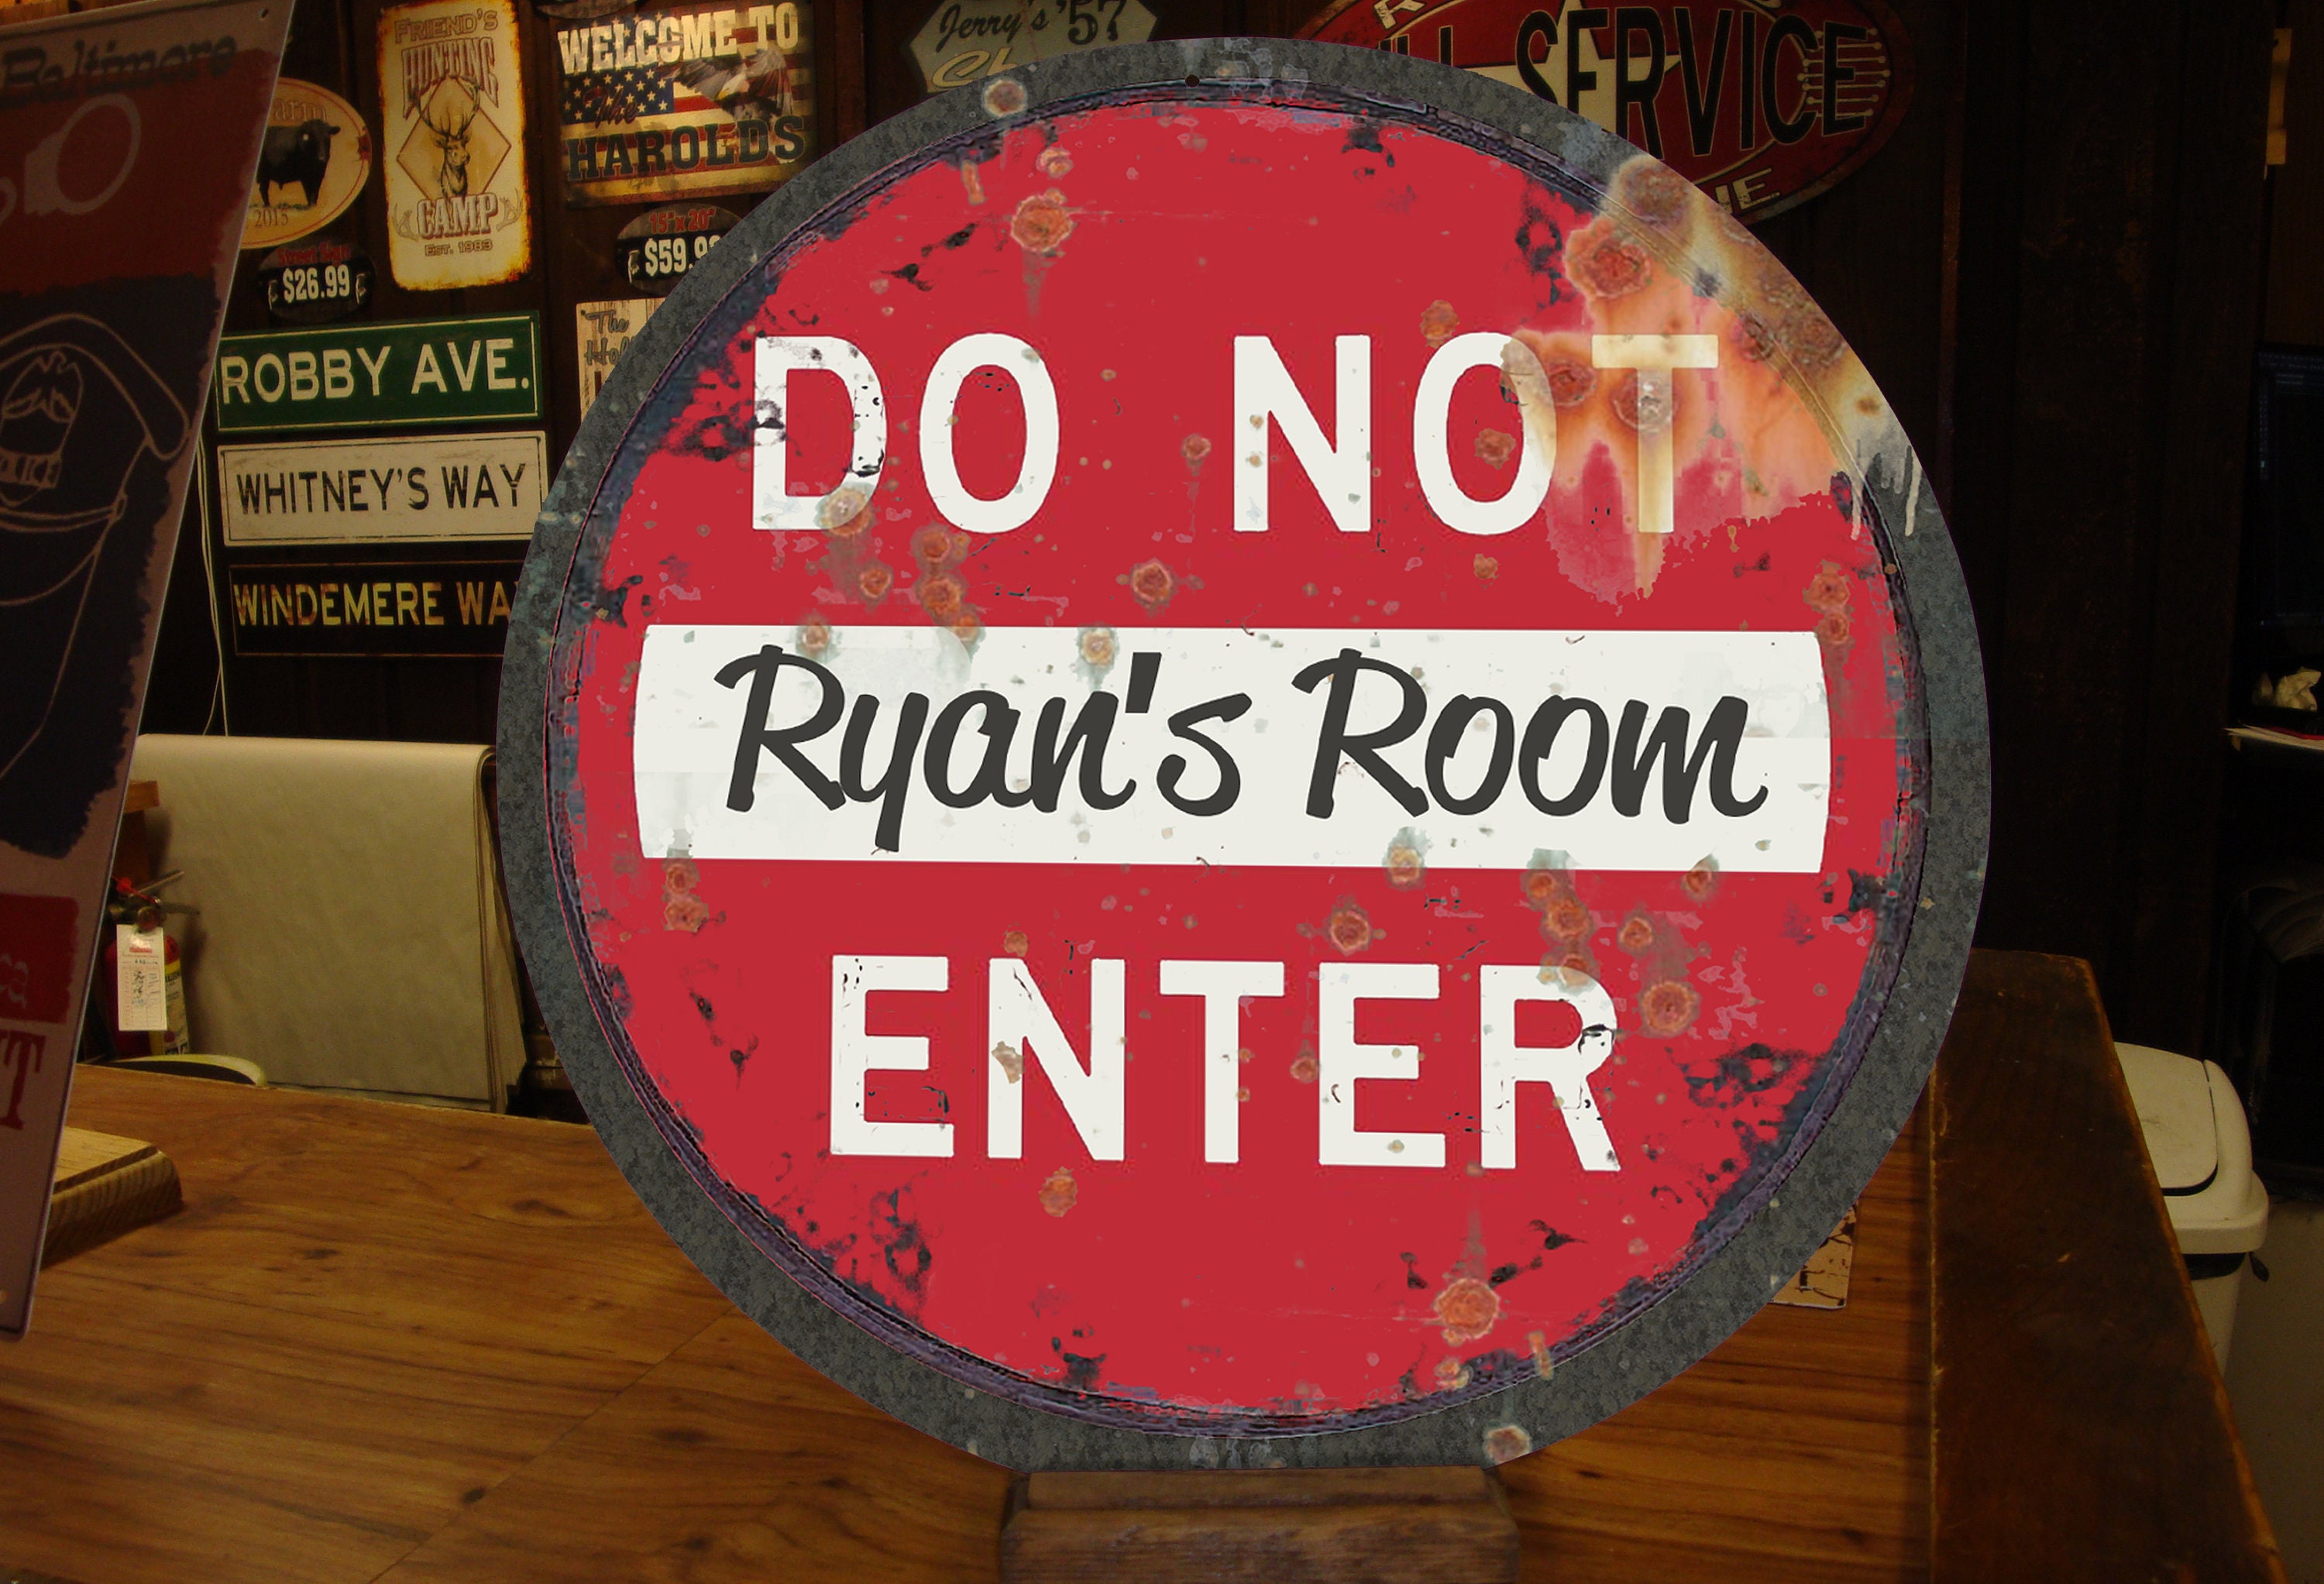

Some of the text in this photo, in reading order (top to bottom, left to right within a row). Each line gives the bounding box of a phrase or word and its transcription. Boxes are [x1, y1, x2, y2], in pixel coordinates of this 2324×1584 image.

[394, 9, 499, 44] FRIEND'S
[556, 2, 799, 75] WELCOME TO
[935, 0, 1049, 53] Jerry's
[0, 36, 237, 110] Baltimore
[401, 36, 500, 121] HUNTING
[1514, 6, 1868, 160] SERVICE
[274, 98, 328, 122] arm
[583, 85, 638, 129] The
[566, 115, 805, 182] HAROLDS
[417, 193, 498, 240] CAMP
[282, 264, 350, 304] $26.99
[585, 310, 630, 334] The
[221, 345, 391, 404] ROBBY
[411, 338, 530, 394] AVE.
[753, 332, 1719, 536] DO NOT
[236, 463, 526, 514] WHITNEY'S WAY
[232, 581, 519, 627] WINDEMERE WA
[713, 644, 1769, 853] Ryan's Room
[830, 954, 1621, 1172] ENTER
